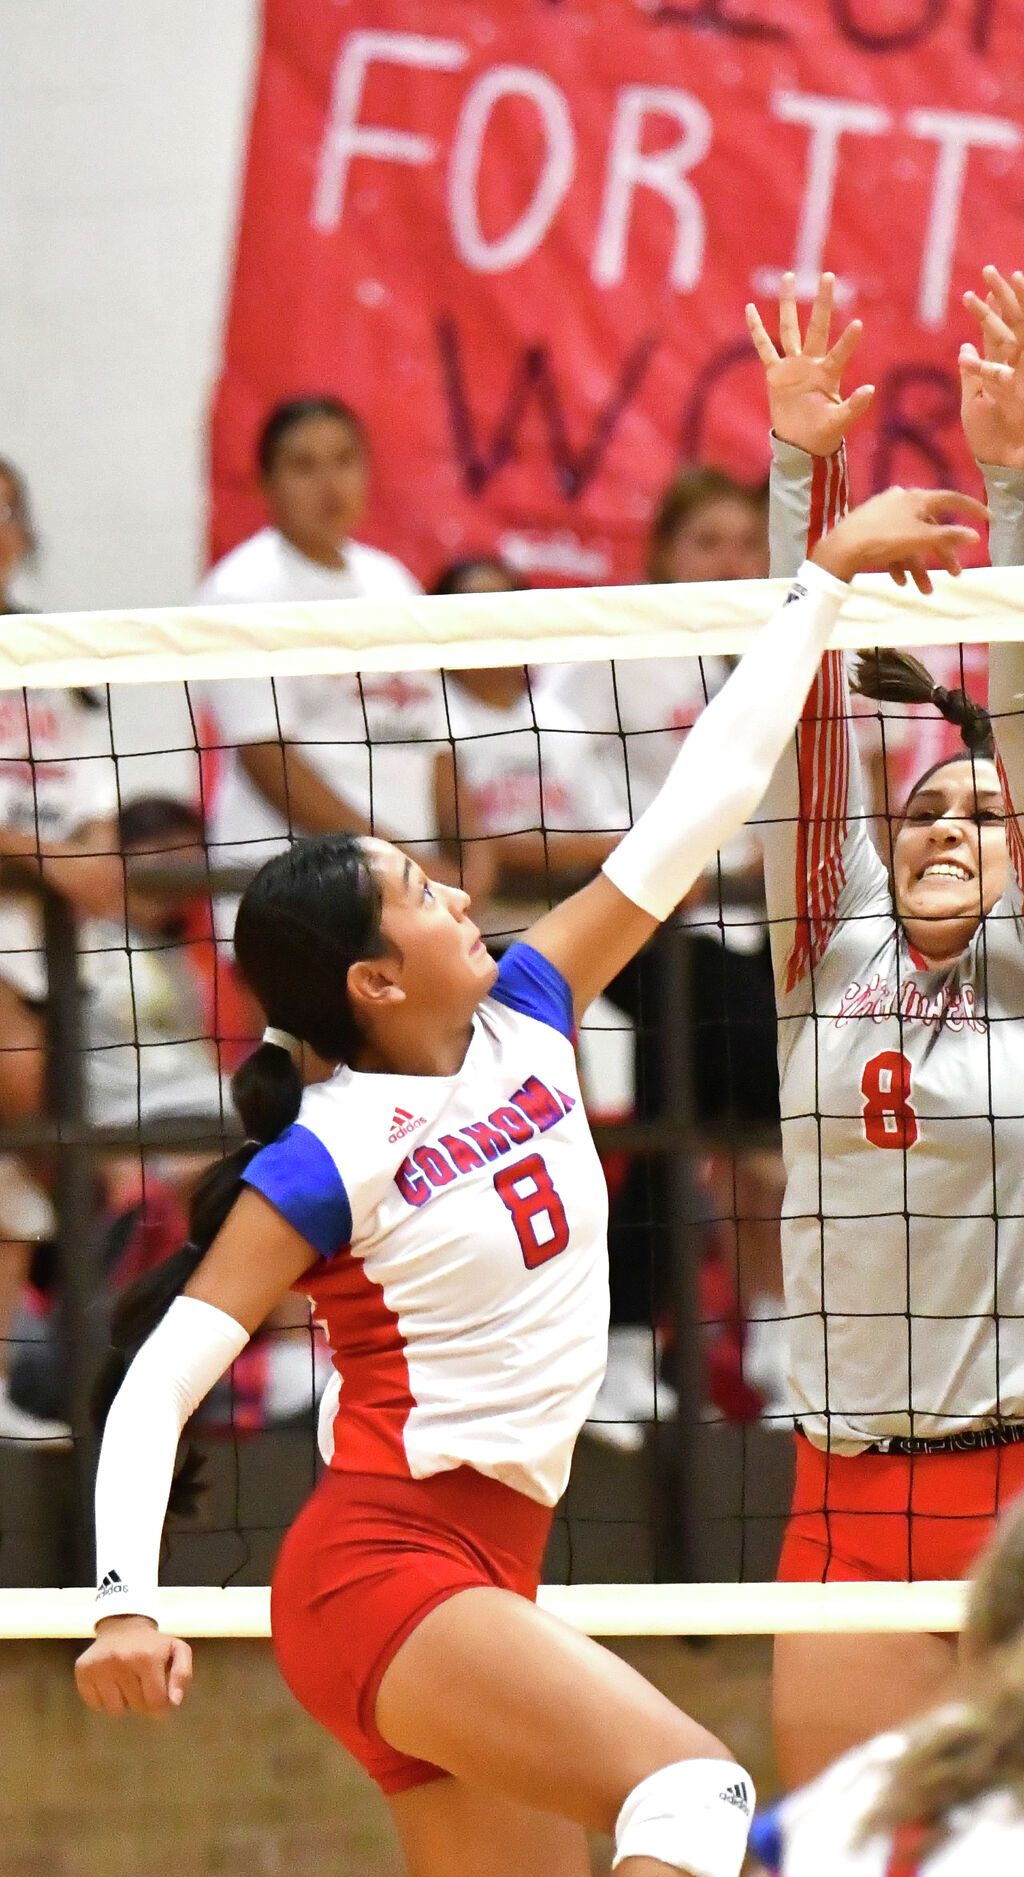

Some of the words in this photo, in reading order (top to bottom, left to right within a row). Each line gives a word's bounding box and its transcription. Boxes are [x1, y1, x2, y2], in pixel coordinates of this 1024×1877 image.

[388, 1116, 428, 1144] adidas
[861, 1050, 919, 1151] 8
[492, 1152, 570, 1271] 8
